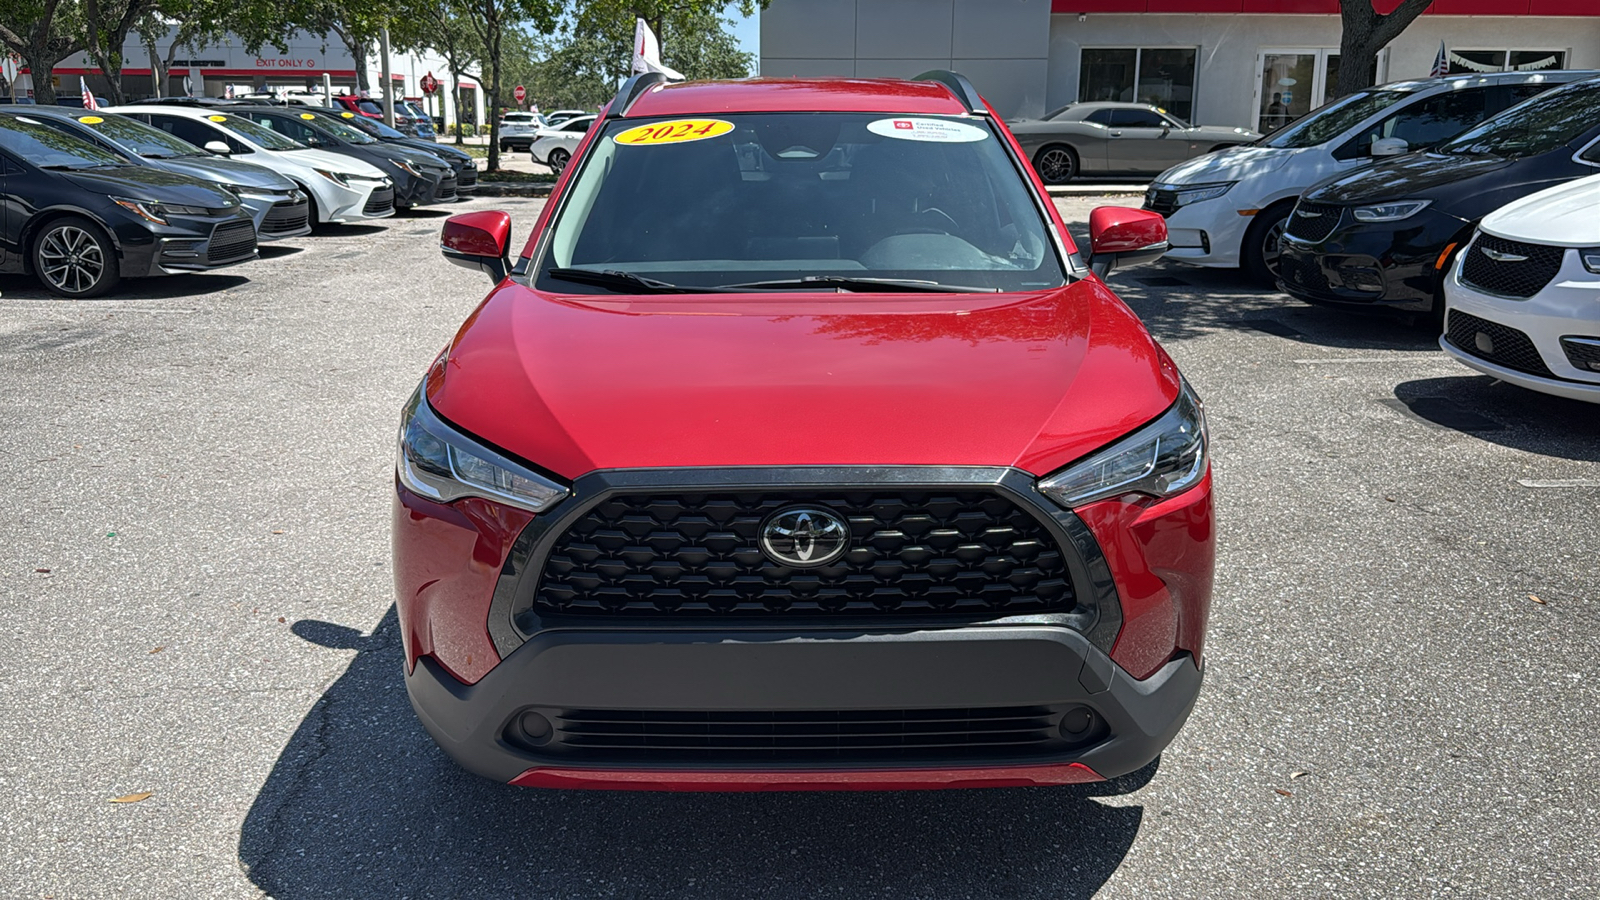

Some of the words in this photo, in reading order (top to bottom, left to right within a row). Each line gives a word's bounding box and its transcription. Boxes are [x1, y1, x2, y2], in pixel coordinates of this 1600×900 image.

[256, 59, 276, 67] EXIT
[278, 59, 303, 68] ONLY
[630, 121, 717, 143] 2024
